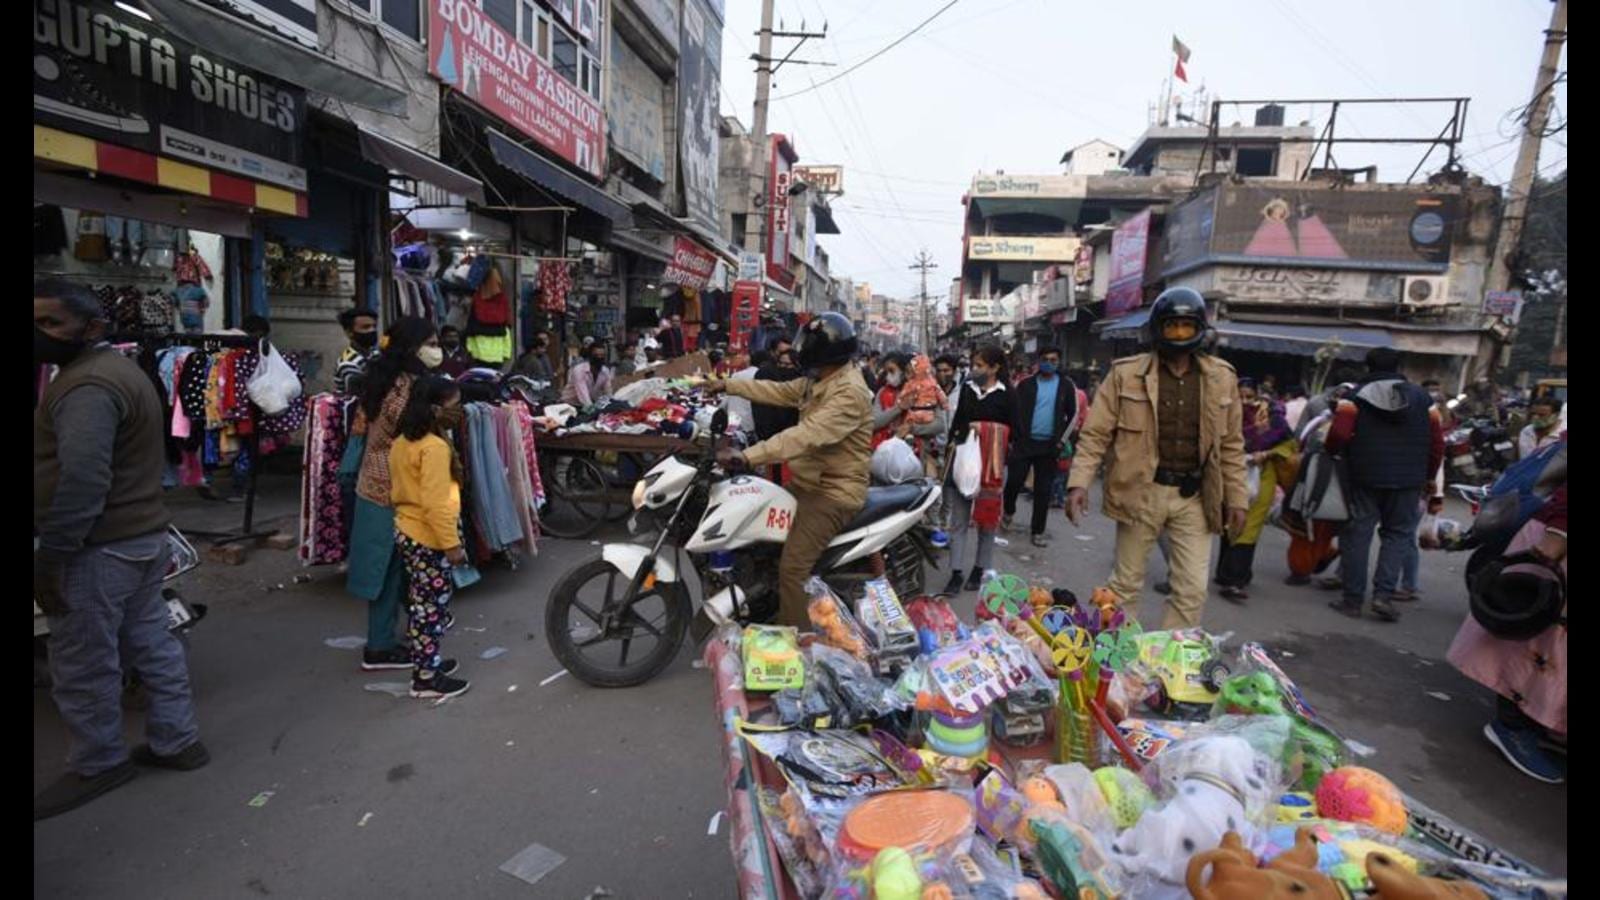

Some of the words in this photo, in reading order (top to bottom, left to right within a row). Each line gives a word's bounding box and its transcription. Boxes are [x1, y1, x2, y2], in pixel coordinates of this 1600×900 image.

[34, 0, 178, 90] GUPTA
[190, 53, 296, 133] SHOES
[438, 0, 532, 82] BOMBAY
[536, 63, 600, 135] FASHION
